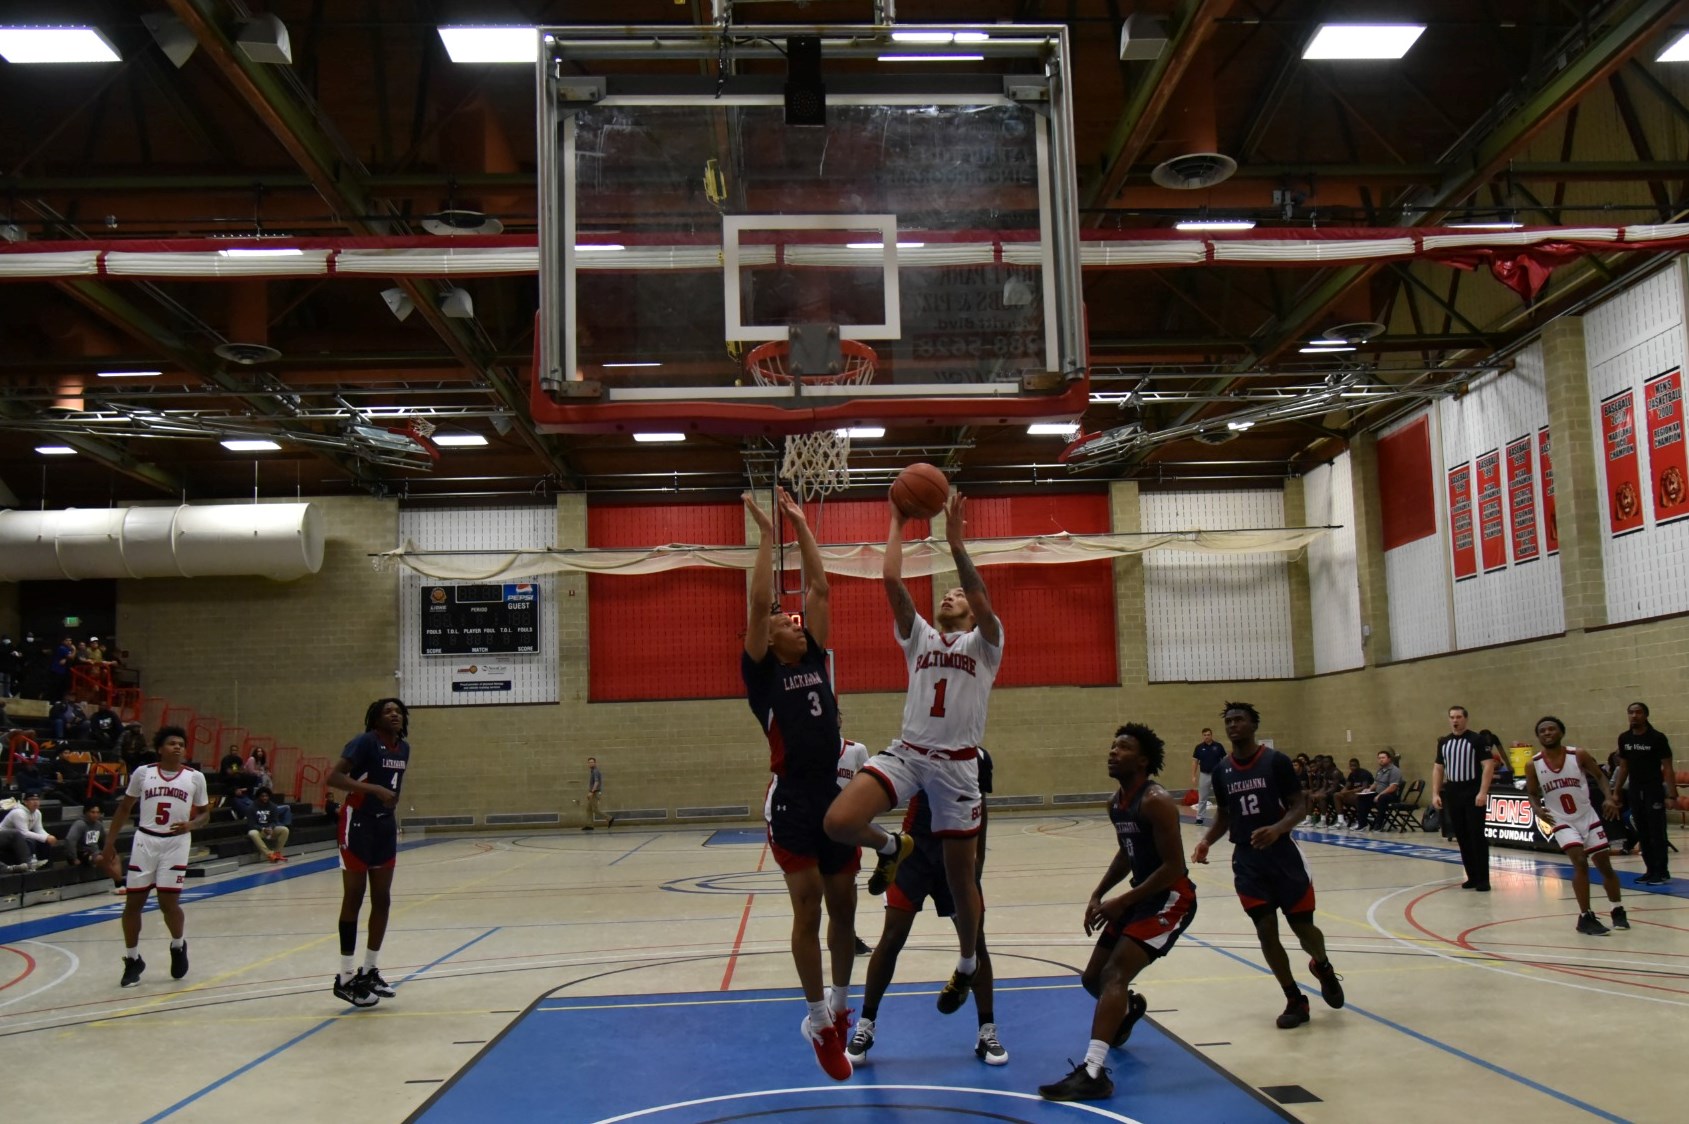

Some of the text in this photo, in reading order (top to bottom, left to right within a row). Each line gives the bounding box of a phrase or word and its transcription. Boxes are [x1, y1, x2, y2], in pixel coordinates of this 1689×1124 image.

[1604, 398, 1632, 416] BASEBALL
[1648, 389, 1682, 410] BASKETBALL
[1658, 404, 1673, 418] 2000
[1654, 433, 1681, 448] CHAMPION
[1508, 442, 1530, 456] BASEBALL
[1610, 446, 1634, 460] CHAMPION
[1478, 457, 1498, 470] BASEBALL
[1451, 472, 1470, 485] BASEBALL
[1514, 496, 1532, 508] CHAMPION
[1515, 516, 1535, 527] CHAMPION
[916, 650, 976, 677] BALTIMORE
[807, 691, 822, 716] 3
[930, 678, 947, 718] 1
[391, 772, 399, 789] 4
[1226, 778, 1266, 794] LACKAWANNA
[1543, 778, 1582, 794] BALTIMORE
[144, 786, 188, 802] BALTIMORE
[1240, 794, 1260, 816] 12
[1560, 794, 1576, 814] 0
[155, 802, 171, 825] 5
[1499, 829, 1534, 842] DUNDALK
